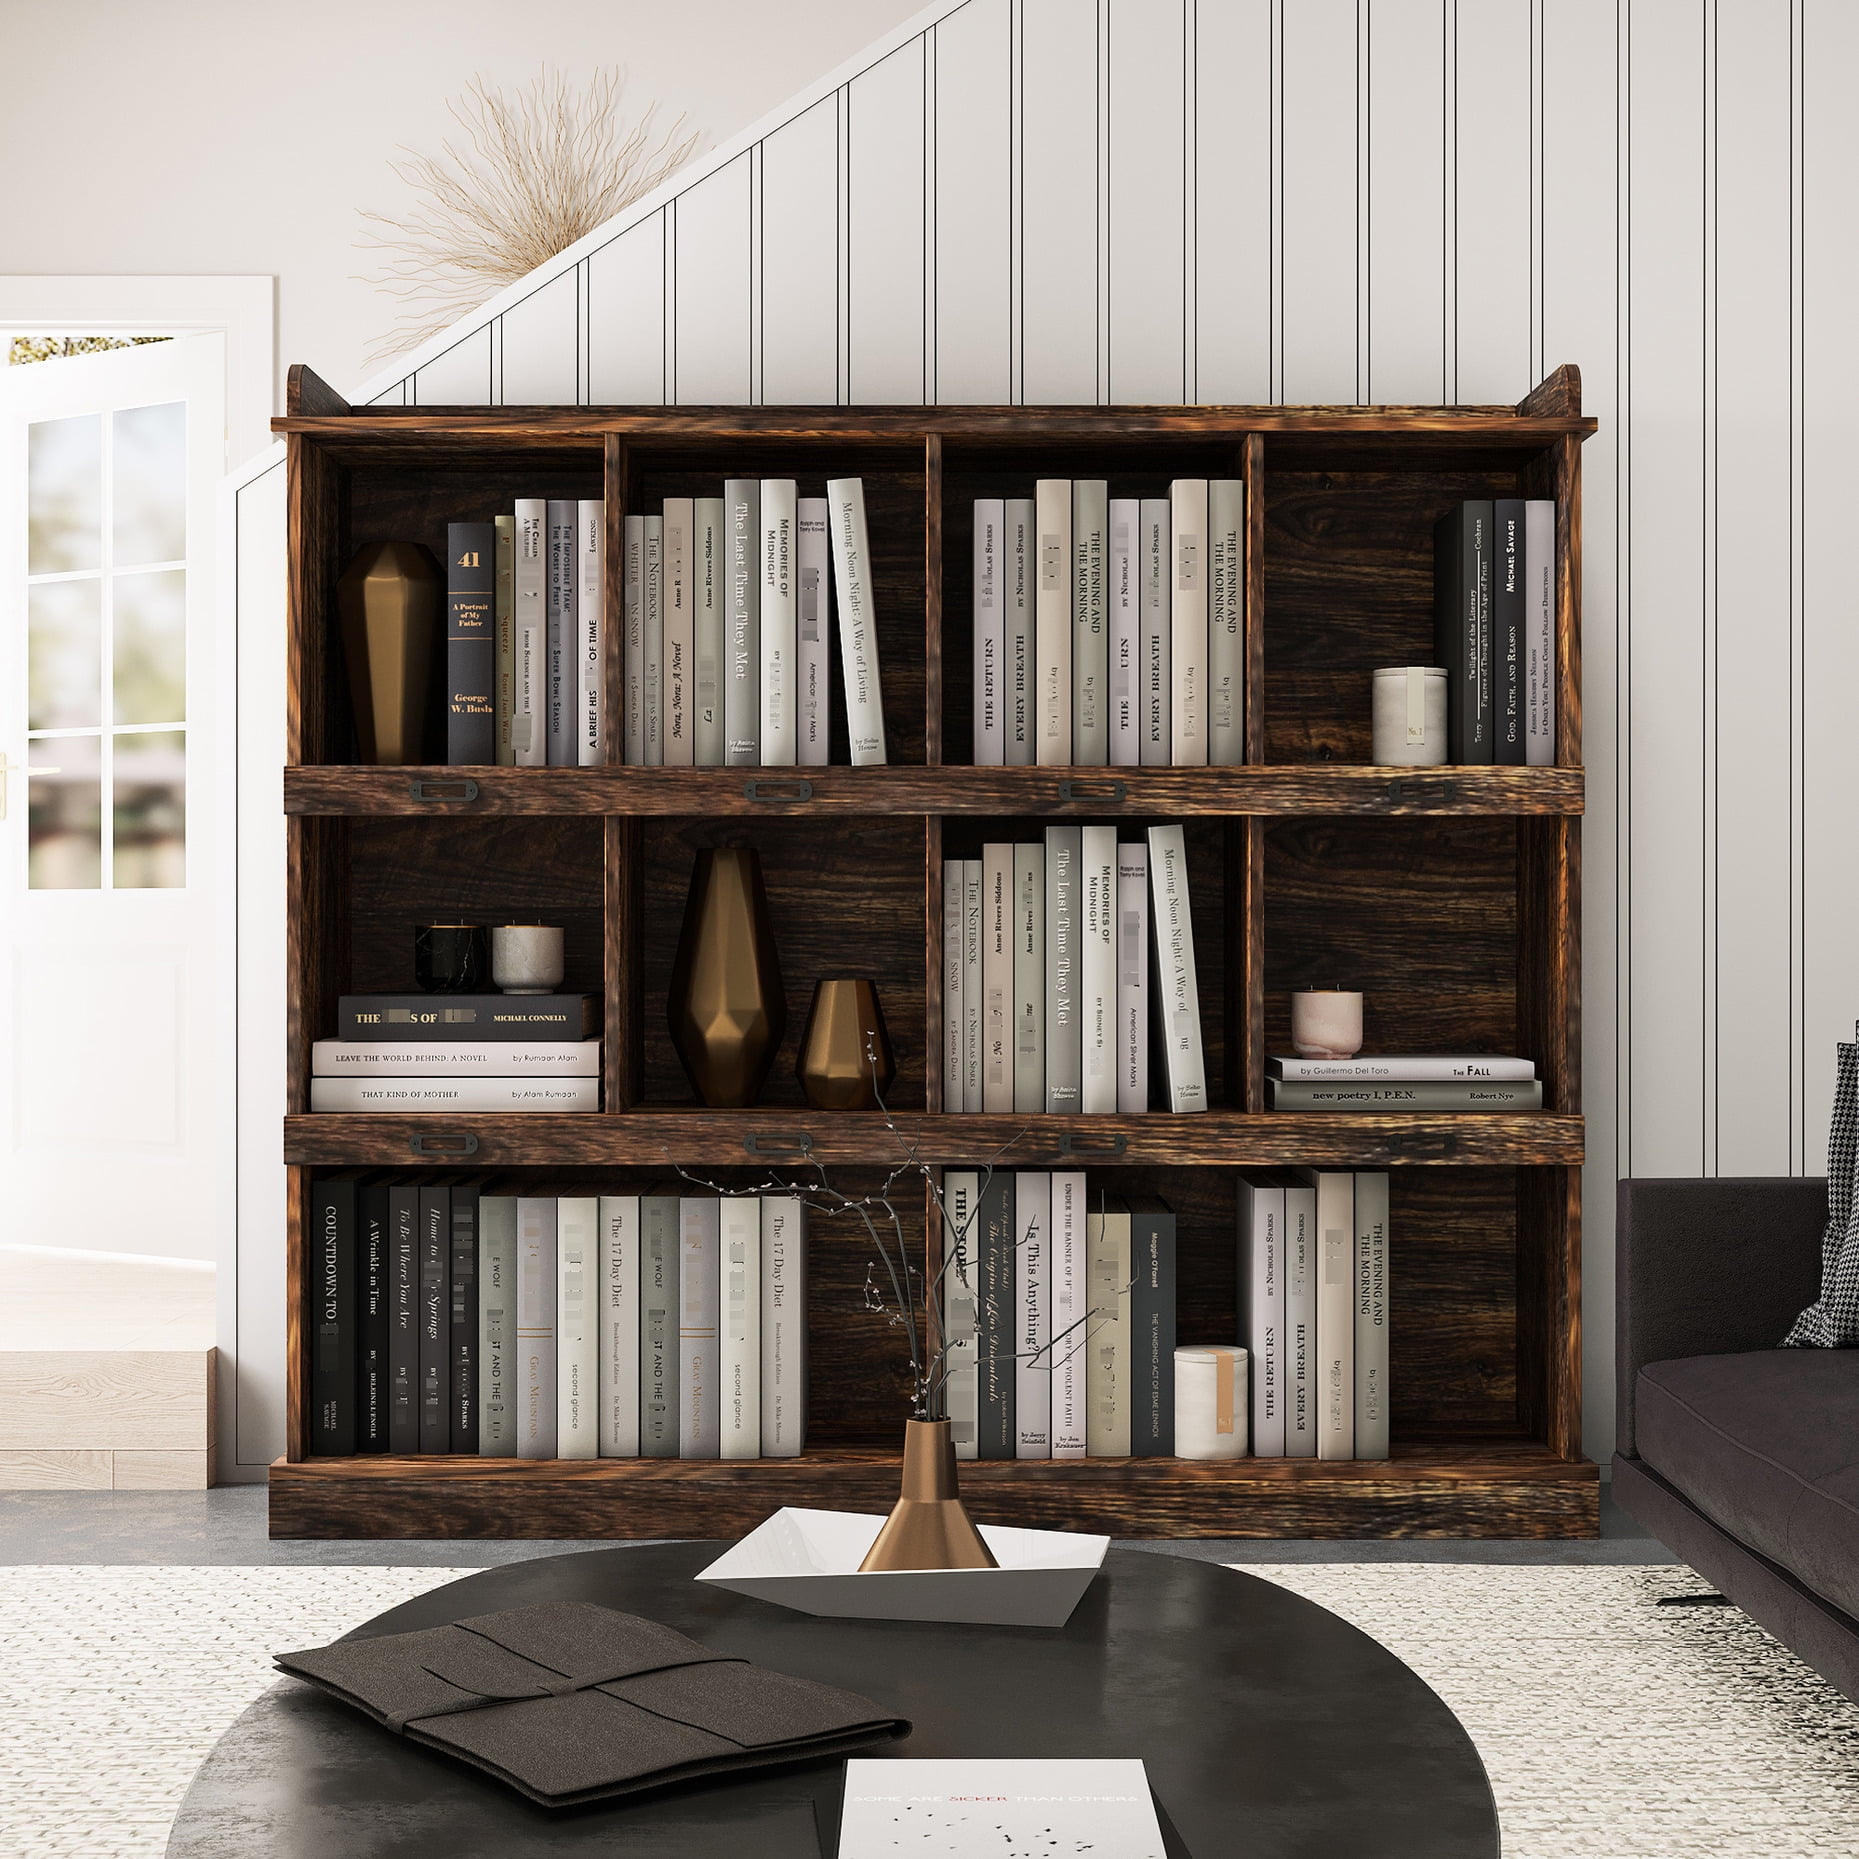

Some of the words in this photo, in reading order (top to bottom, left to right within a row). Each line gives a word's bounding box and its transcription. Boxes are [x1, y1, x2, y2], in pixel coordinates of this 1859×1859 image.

[735, 502, 748, 530] The
[842, 502, 856, 547] Morning
[735, 534, 748, 566] Last
[780, 519, 789, 579] MEMORIES
[1079, 542, 1088, 565] THE
[1091, 531, 1101, 554] THE
[457, 552, 481, 568] 41
[767, 530, 776, 587] MIDNIGHT
[847, 551, 857, 578] Noon
[735, 571, 748, 607] Time
[780, 583, 789, 597] OF
[1091, 557, 1101, 606] EVENING
[453, 603, 459, 611] A
[459, 603, 489, 611] Portrait
[848, 582, 861, 617] Night:
[1079, 567, 1088, 623] MORNING
[1468, 588, 1477, 622] Literary
[461, 611, 467, 619] of
[467, 611, 480, 621] My
[732, 611, 748, 646] They
[853, 619, 862, 627] A
[1091, 609, 1101, 634] AND
[502, 615, 510, 654] Squeeze
[589, 620, 598, 644] TIME
[853, 629, 864, 653] Way
[1468, 624, 1477, 636] the
[1468, 637, 1477, 645] of
[589, 646, 598, 661] OF
[672, 640, 683, 671] Novel
[735, 652, 748, 680] Met
[857, 656, 867, 666] of
[1016, 634, 1024, 691] BREATH
[1468, 646, 1477, 680] Twilight
[672, 672, 683, 682] A
[985, 637, 993, 697] RETURN
[455, 694, 488, 704] George
[672, 684, 683, 710] Nora:
[857, 669, 869, 704] Living
[452, 704, 465, 713] W.
[467, 704, 493, 713] Bush
[985, 701, 993, 730] THE
[1016, 695, 1024, 742] EVERY
[589, 710, 598, 737] BRIEF
[672, 712, 683, 738] Nora,
[589, 739, 598, 749] A
[355, 1013, 381, 1024] THE
[420, 1013, 438, 1024] OF
[493, 1014, 527, 1022] MICHAEL
[528, 1014, 567, 1022] CONNELLY
[513, 1055, 523, 1063] by
[1300, 1066, 1312, 1076] by
[1313, 1066, 1353, 1075] Guillermo
[1355, 1066, 1369, 1075] Del
[1371, 1066, 1389, 1075] Toro
[1467, 1066, 1491, 1076] FALL
[361, 1091, 385, 1099] THAT
[386, 1091, 407, 1099] KIND
[410, 1091, 422, 1099] OF
[423, 1091, 459, 1099] MOTHER
[511, 1091, 522, 1100] by
[1337, 1090, 1372, 1102] poetry
[1383, 1090, 1416, 1100] P.E.N.
[1469, 1092, 1496, 1100] Robert
[1498, 1092, 1514, 1102] Nye
[369, 1219, 379, 1228] A
[399, 1208, 411, 1223] To
[430, 1208, 440, 1242] Home
[773, 1216, 785, 1239] The
[399, 1225, 411, 1240] Be
[1028, 1226, 1040, 1238] Is
[1373, 1223, 1383, 1246] THE
[325, 1205, 336, 1297] COUNTDOWN
[369, 1230, 379, 1272] Wrinkle
[430, 1244, 439, 1256] to
[773, 1242, 785, 1255] 17
[1150, 1232, 1160, 1258] Maggie
[1361, 1234, 1370, 1257] THE
[399, 1243, 411, 1280] Where
[771, 1258, 785, 1281] Day
[1028, 1244, 1040, 1275] This
[369, 1275, 379, 1286] in
[1373, 1249, 1383, 1298] EVENING
[399, 1282, 411, 1303] You
[773, 1284, 785, 1308] Diet
[1361, 1260, 1370, 1315] MORNING
[325, 1300, 336, 1319] TO
[369, 1288, 379, 1315] Time
[1373, 1301, 1383, 1326] AND
[399, 1307, 411, 1329] Are
[427, 1293, 441, 1340] Springs
[1026, 1279, 1040, 1353] Anything?
[1266, 1327, 1275, 1386] RETURN
[1296, 1323, 1305, 1380] BREATH
[571, 1364, 580, 1396] second
[570, 1398, 580, 1429] glance
[1266, 1390, 1275, 1420] THE
[1296, 1384, 1305, 1431] EVERY
